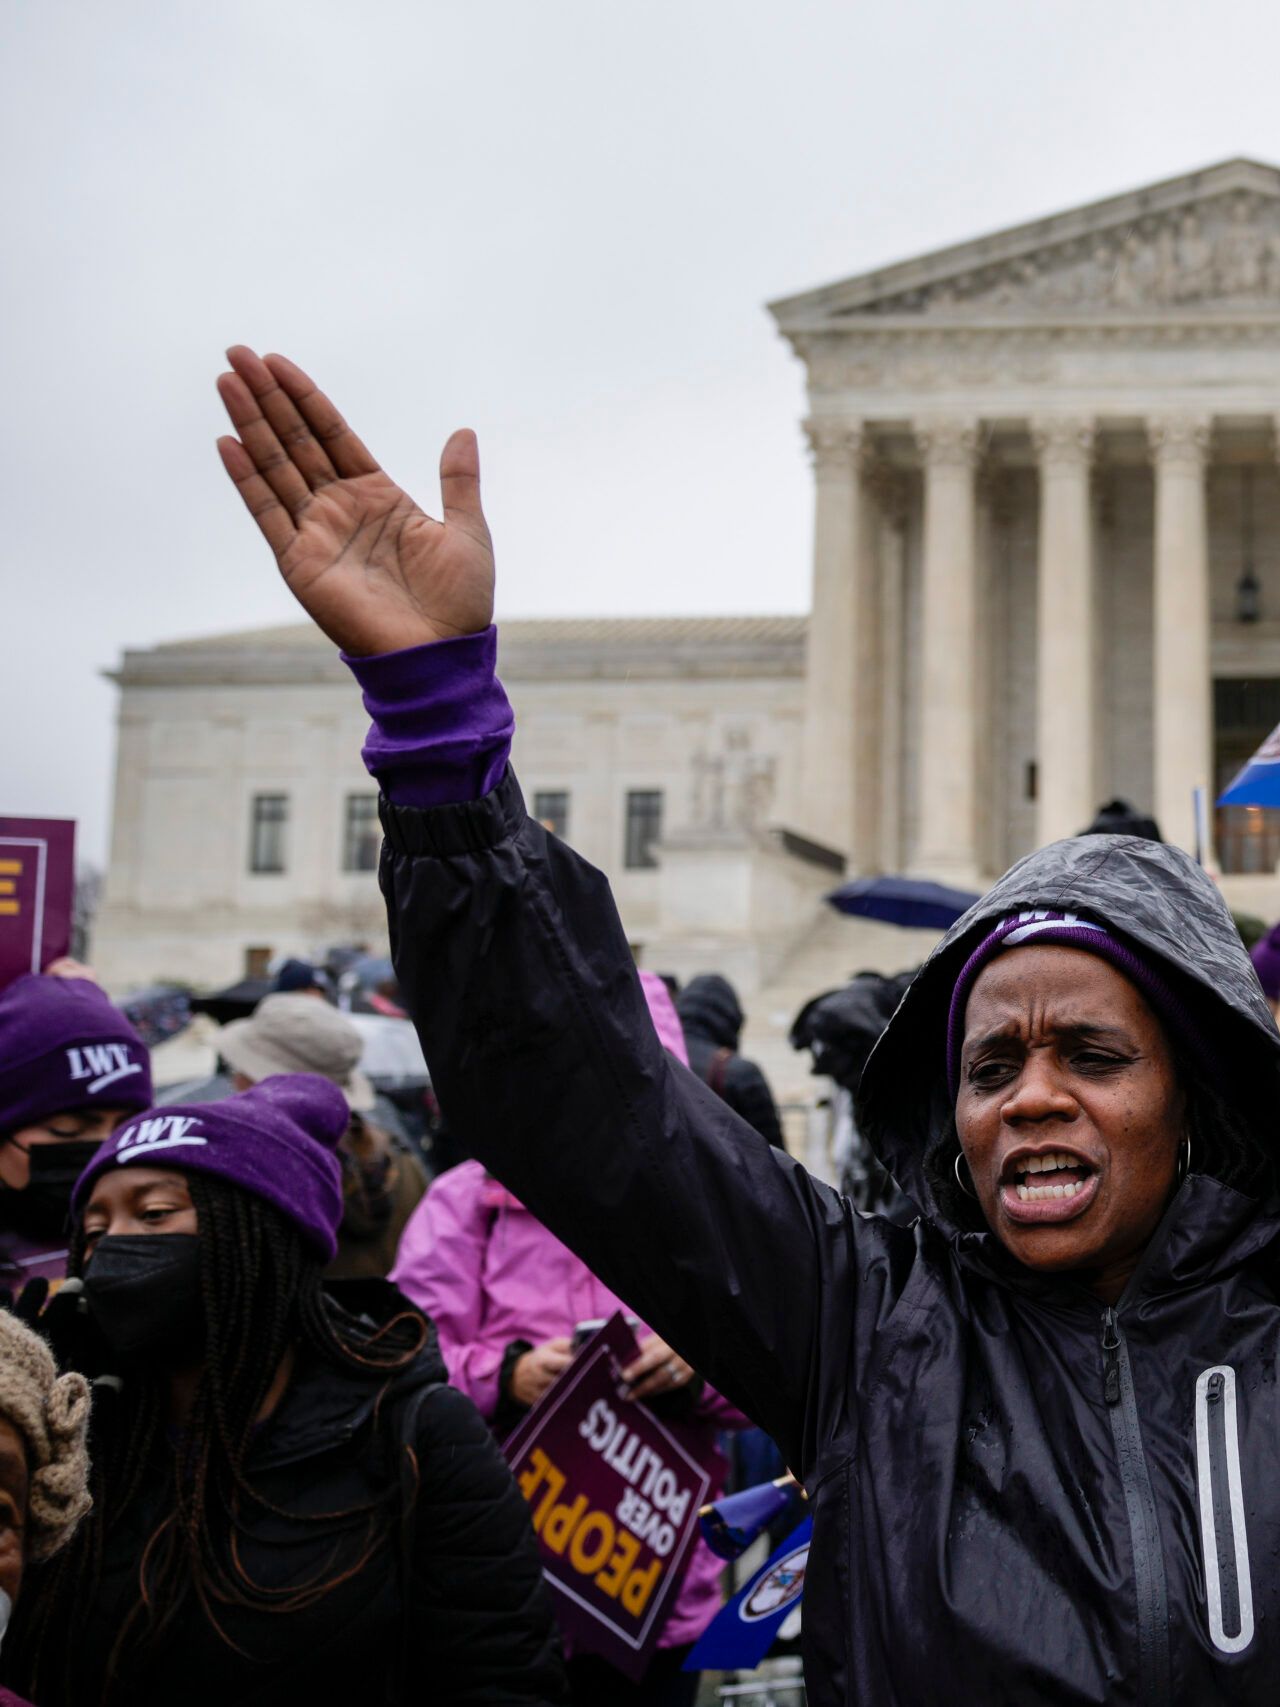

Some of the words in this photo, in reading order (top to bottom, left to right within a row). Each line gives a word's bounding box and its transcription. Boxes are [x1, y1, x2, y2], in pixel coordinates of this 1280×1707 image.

[66, 1043, 142, 1094] LWV
[117, 1115, 207, 1163] LWV
[579, 1399, 691, 1527] POLITICS
[615, 1487, 675, 1557] OVER
